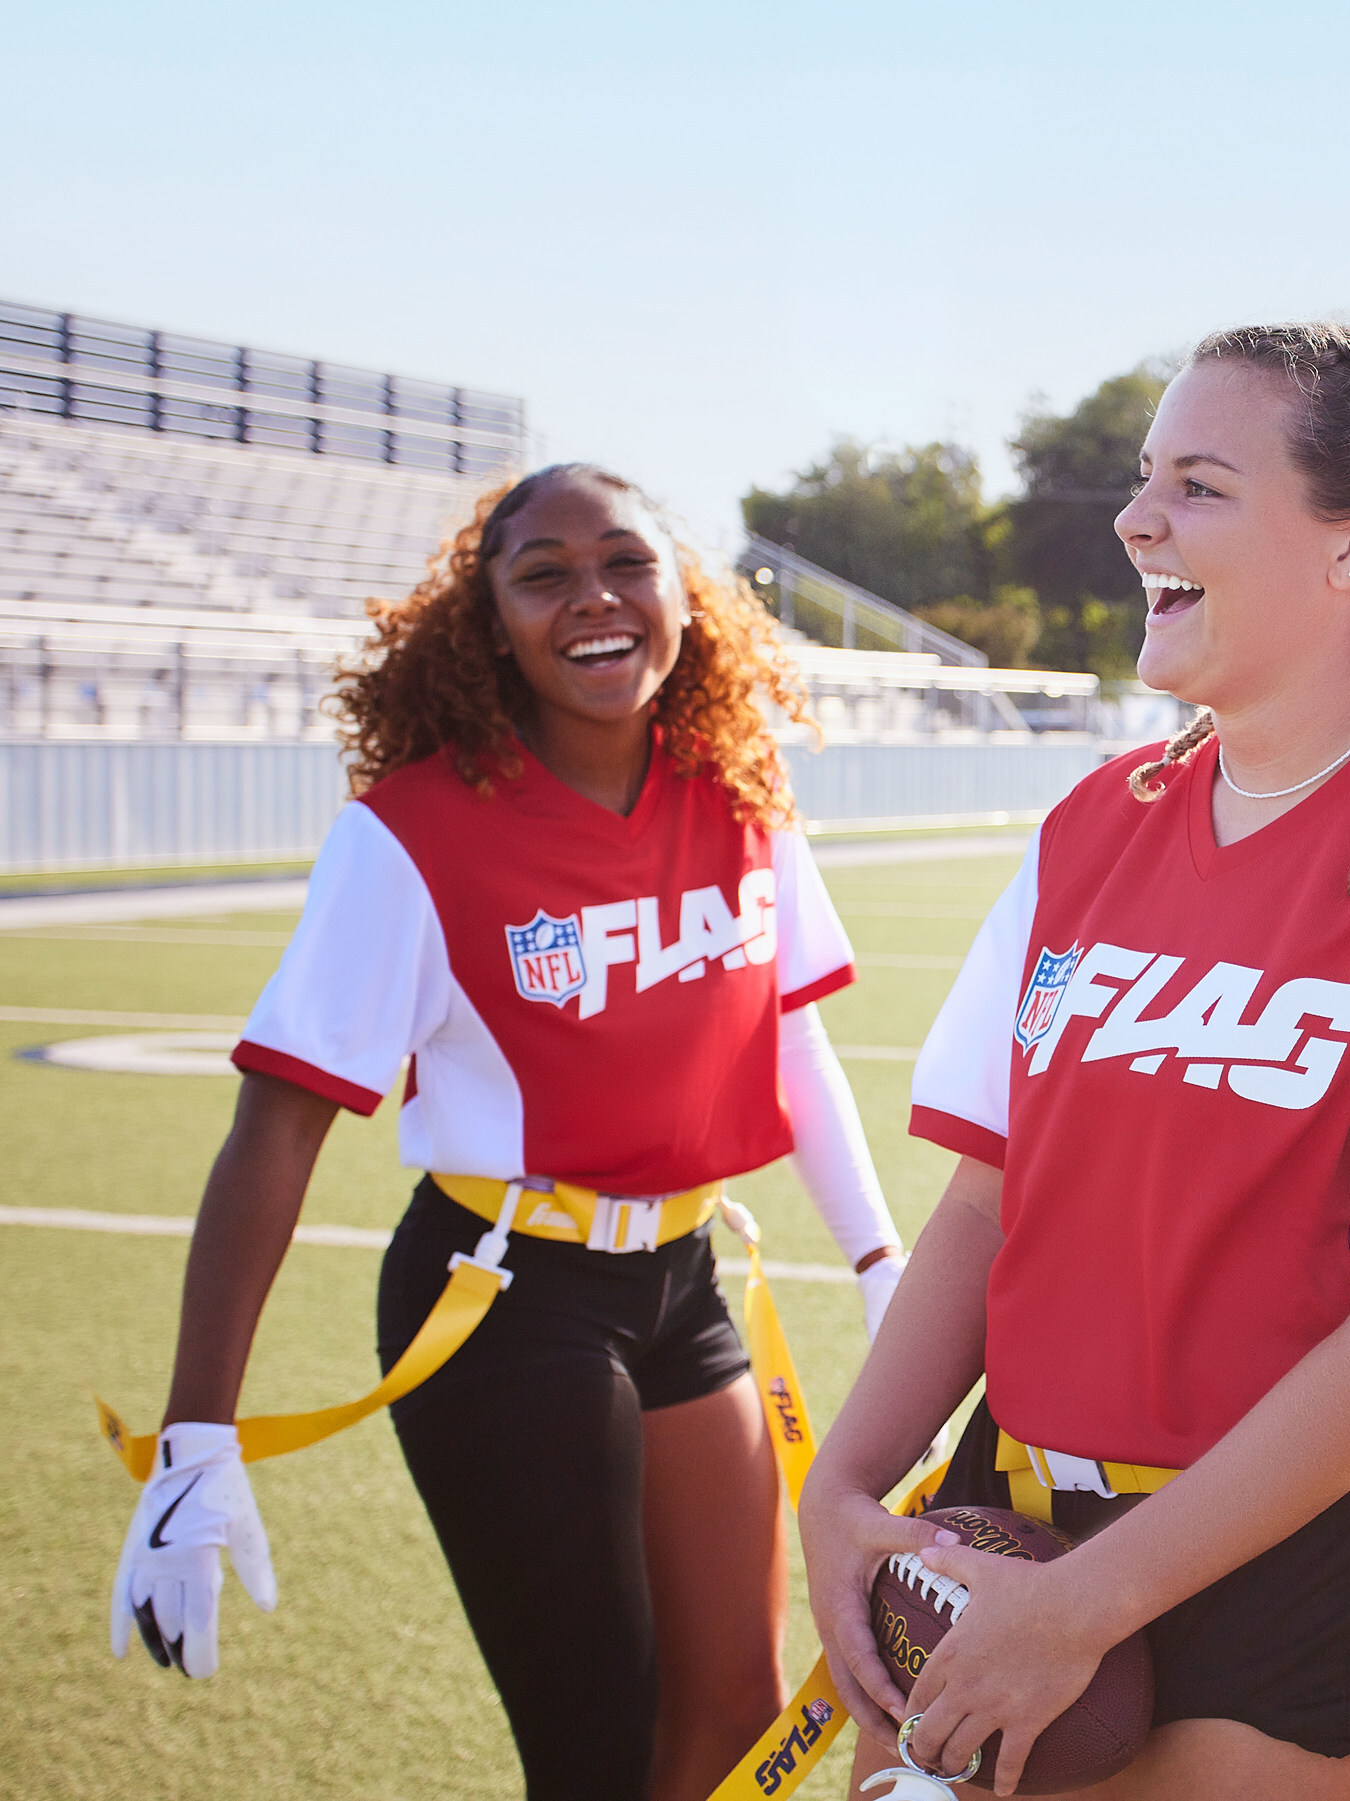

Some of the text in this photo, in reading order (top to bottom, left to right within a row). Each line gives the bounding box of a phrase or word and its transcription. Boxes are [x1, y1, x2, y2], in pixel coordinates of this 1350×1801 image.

[523, 951, 581, 991] NFL
[1021, 989, 1059, 1037] NFL
[754, 1701, 827, 1796] NFL FLAG
